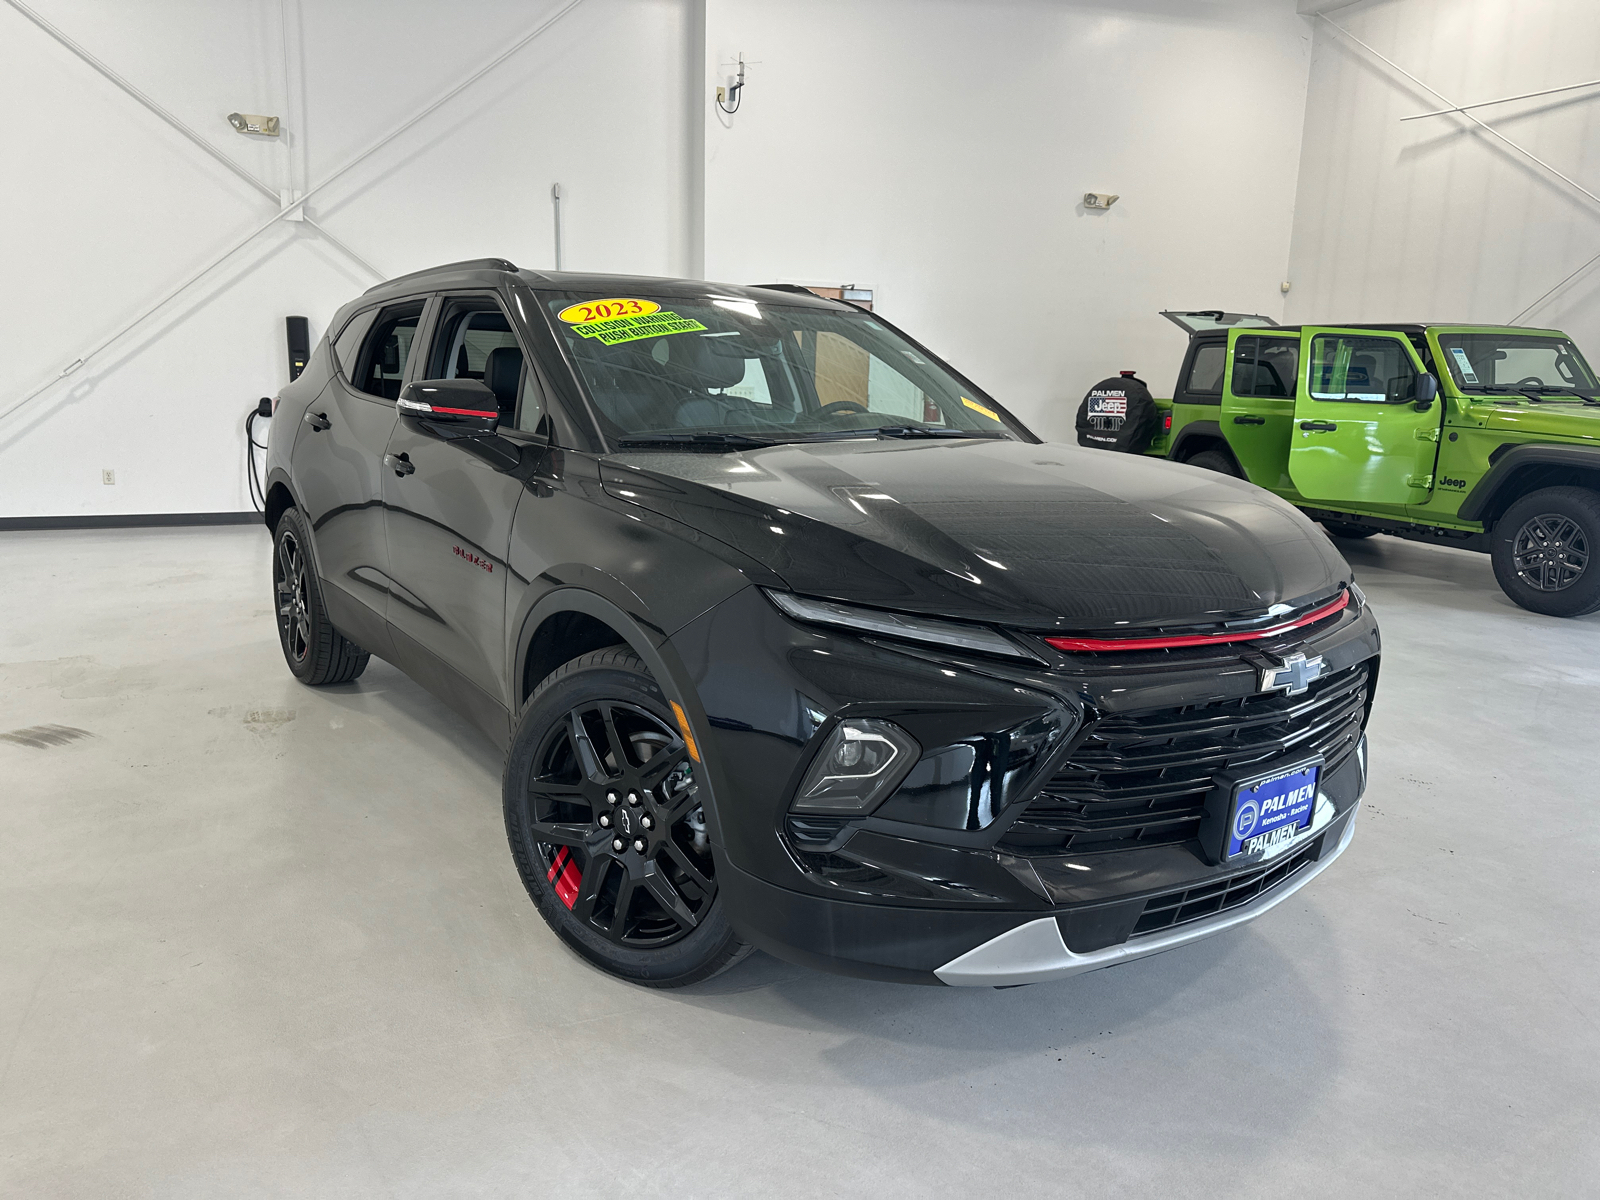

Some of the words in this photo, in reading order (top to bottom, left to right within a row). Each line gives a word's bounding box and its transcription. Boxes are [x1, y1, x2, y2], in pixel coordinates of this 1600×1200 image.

[578, 300, 643, 321] 2023
[577, 318, 635, 335] COLLISION
[634, 312, 683, 326] WARNING
[600, 330, 630, 343] PUSH
[629, 324, 669, 337] BUTTON
[668, 320, 700, 332] START
[1094, 400, 1121, 414] Jeep
[1439, 475, 1467, 489] Jeep
[1260, 782, 1316, 816] PALMEN
[1262, 812, 1287, 827] Kenosha
[1290, 804, 1309, 817] Racine
[1248, 823, 1297, 855] PALMEN
